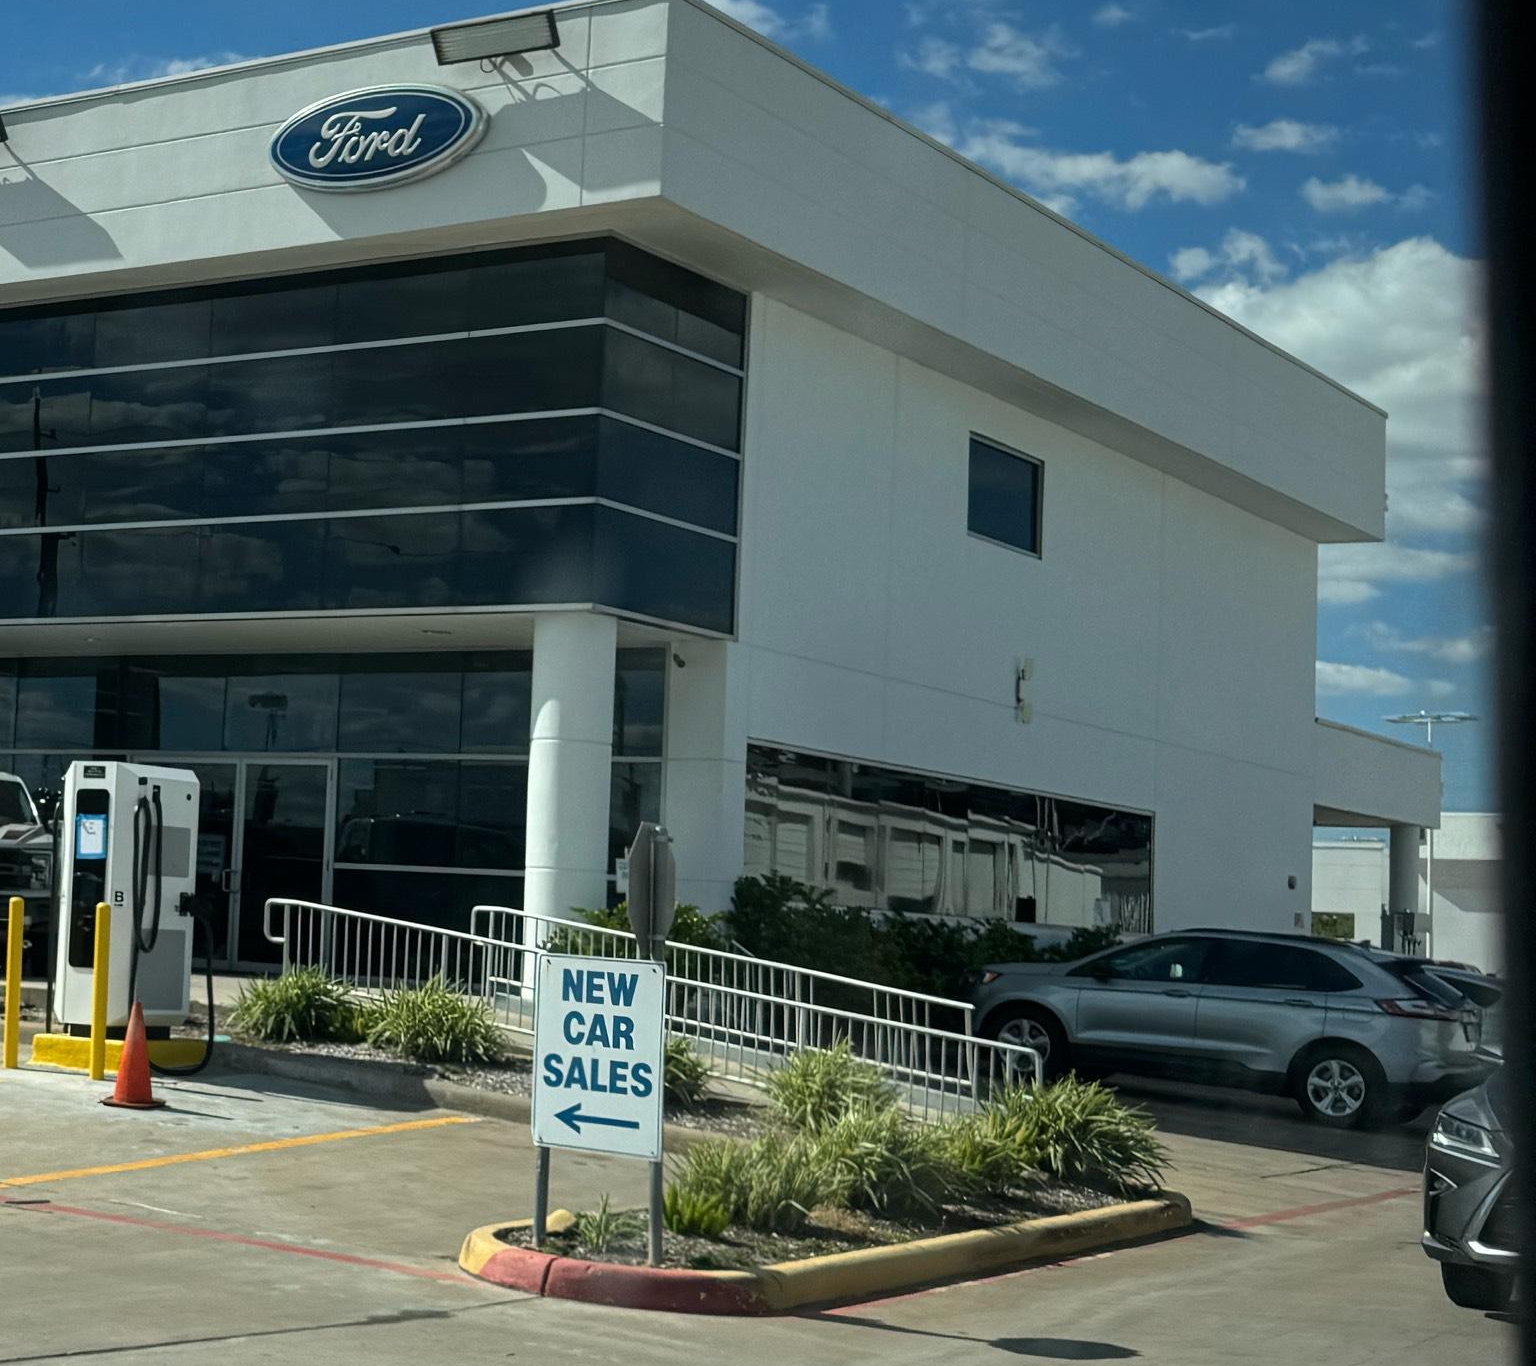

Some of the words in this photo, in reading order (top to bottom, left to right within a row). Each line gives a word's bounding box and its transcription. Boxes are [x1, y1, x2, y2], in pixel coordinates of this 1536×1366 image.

[308, 106, 427, 168] Ford
[562, 968, 639, 1007] NEW
[563, 1010, 635, 1050] CAR
[543, 1053, 653, 1098] SALES
